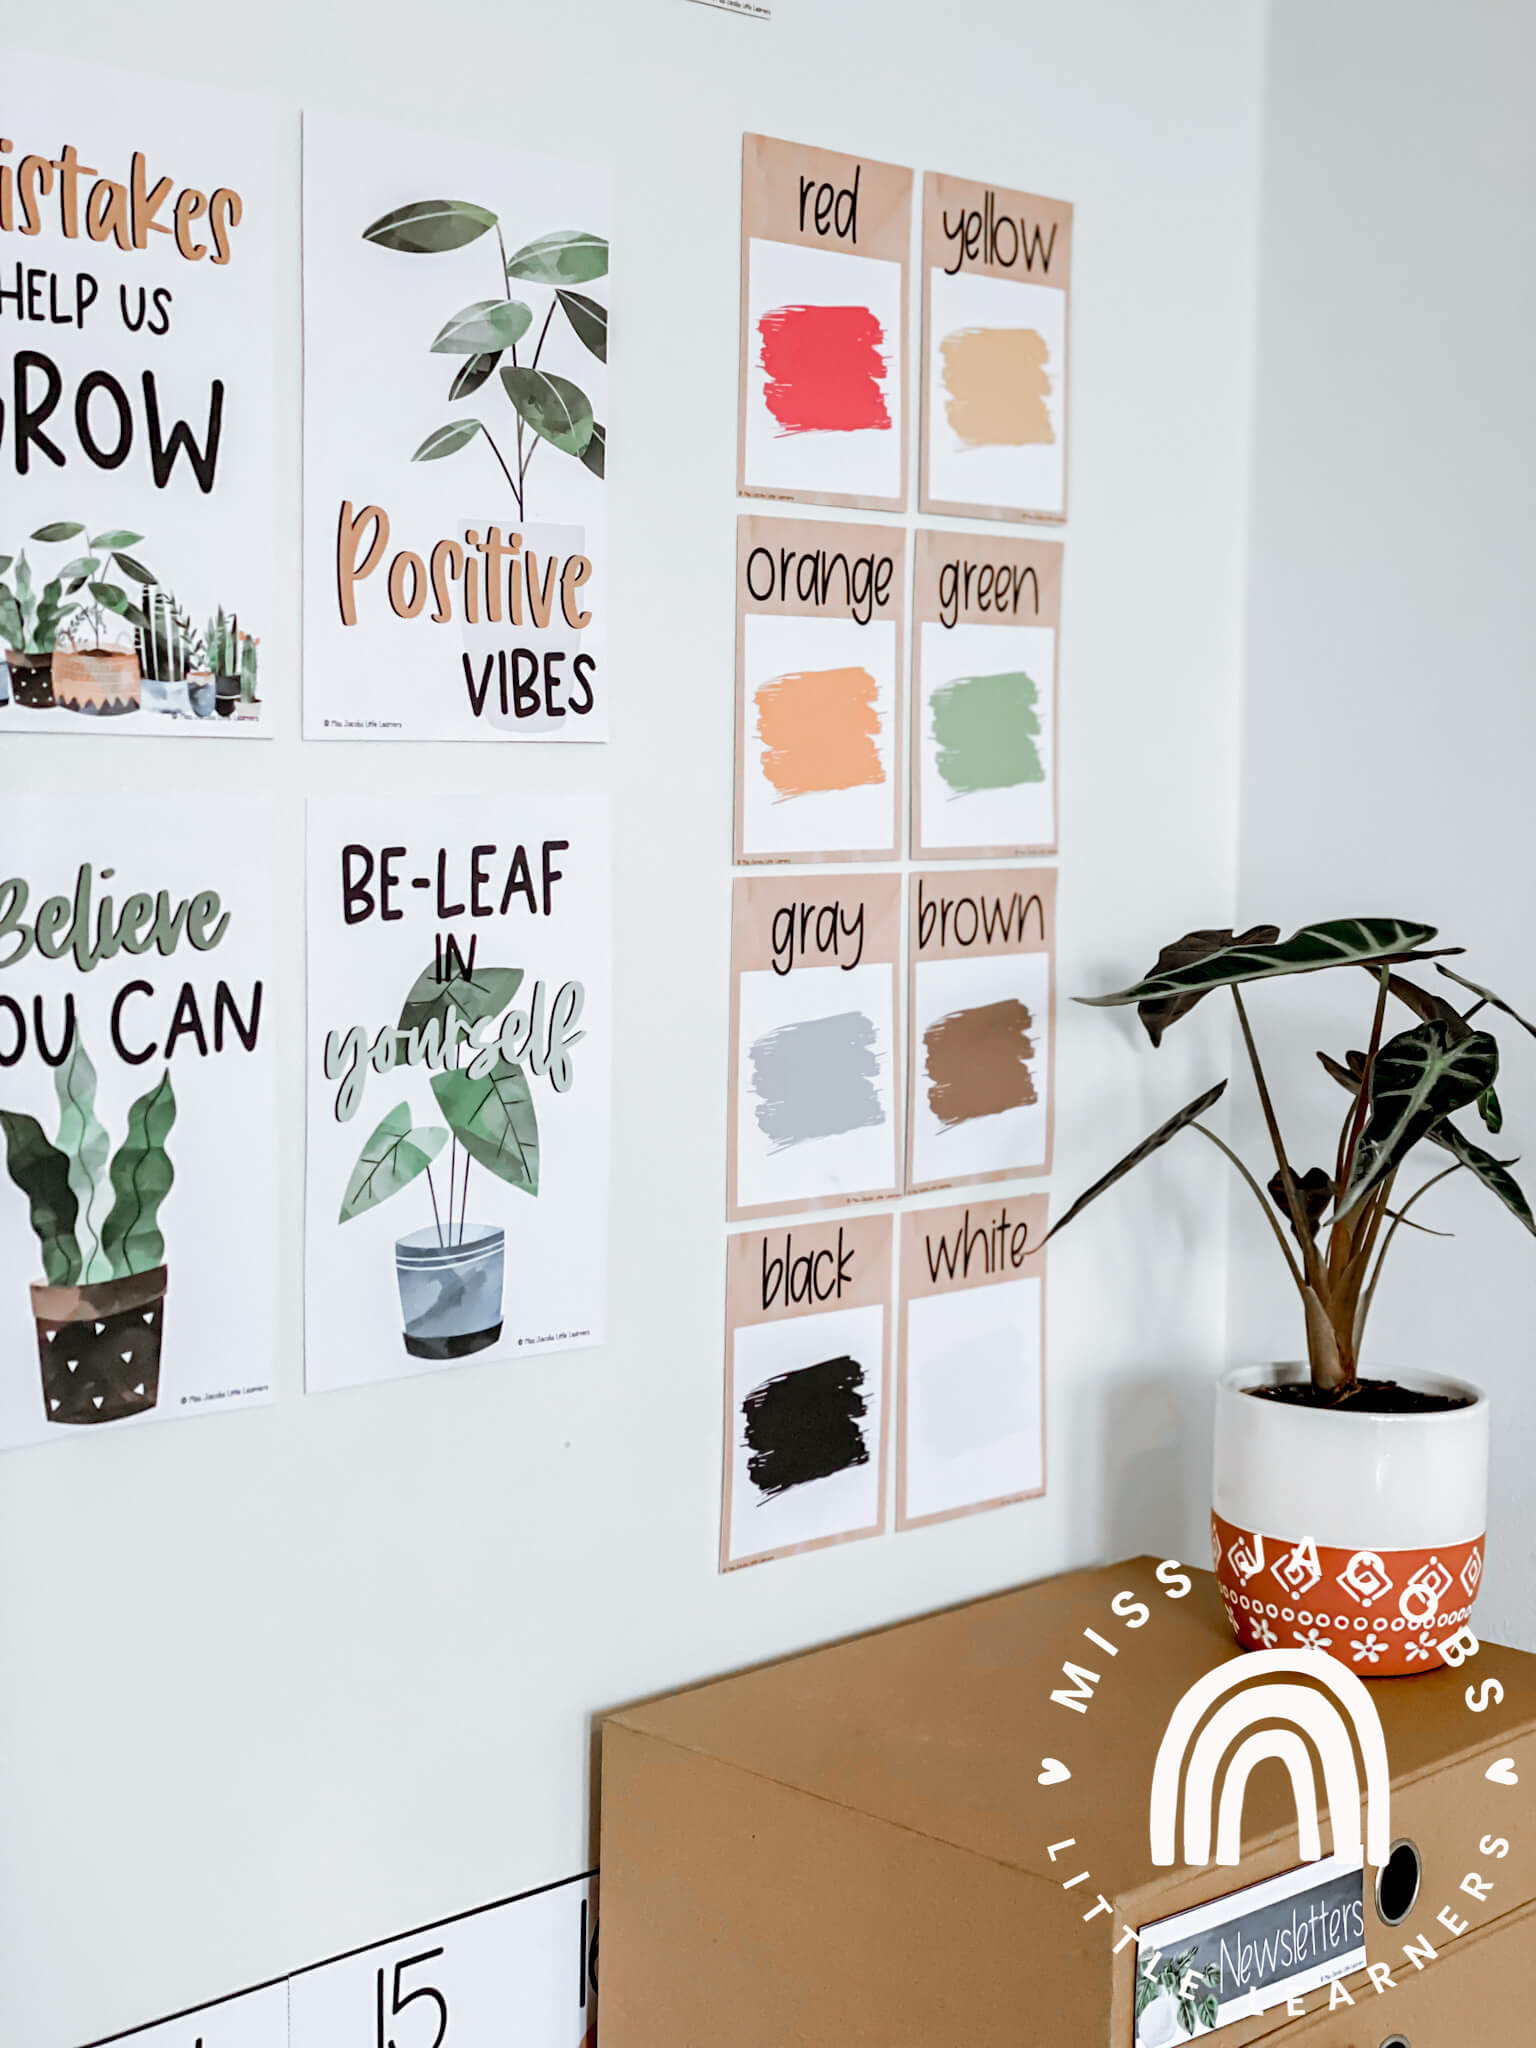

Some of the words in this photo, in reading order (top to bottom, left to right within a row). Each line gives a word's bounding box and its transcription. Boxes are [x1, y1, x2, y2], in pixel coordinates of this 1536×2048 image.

[799, 165, 861, 244] red
[943, 190, 1057, 276] yellow
[0, 261, 98, 329] HELP
[119, 284, 173, 336] US
[0, 350, 225, 494] ROW
[336, 499, 593, 629] Positive
[746, 547, 894, 626] orange
[939, 559, 1040, 630] green
[462, 647, 597, 719] VIBES
[0, 862, 231, 973] Believe
[342, 840, 569, 925] BE-LEAF
[918, 879, 1045, 950] brown
[435, 932, 478, 985] IN
[772, 901, 864, 976] gray
[110, 979, 263, 1065] CAN
[324, 979, 588, 1122] yourself
[762, 1226, 855, 1310] black
[925, 1207, 1029, 1283] white
[1219, 1899, 1364, 1994] Newsletters
[376, 1946, 448, 2048] 15
